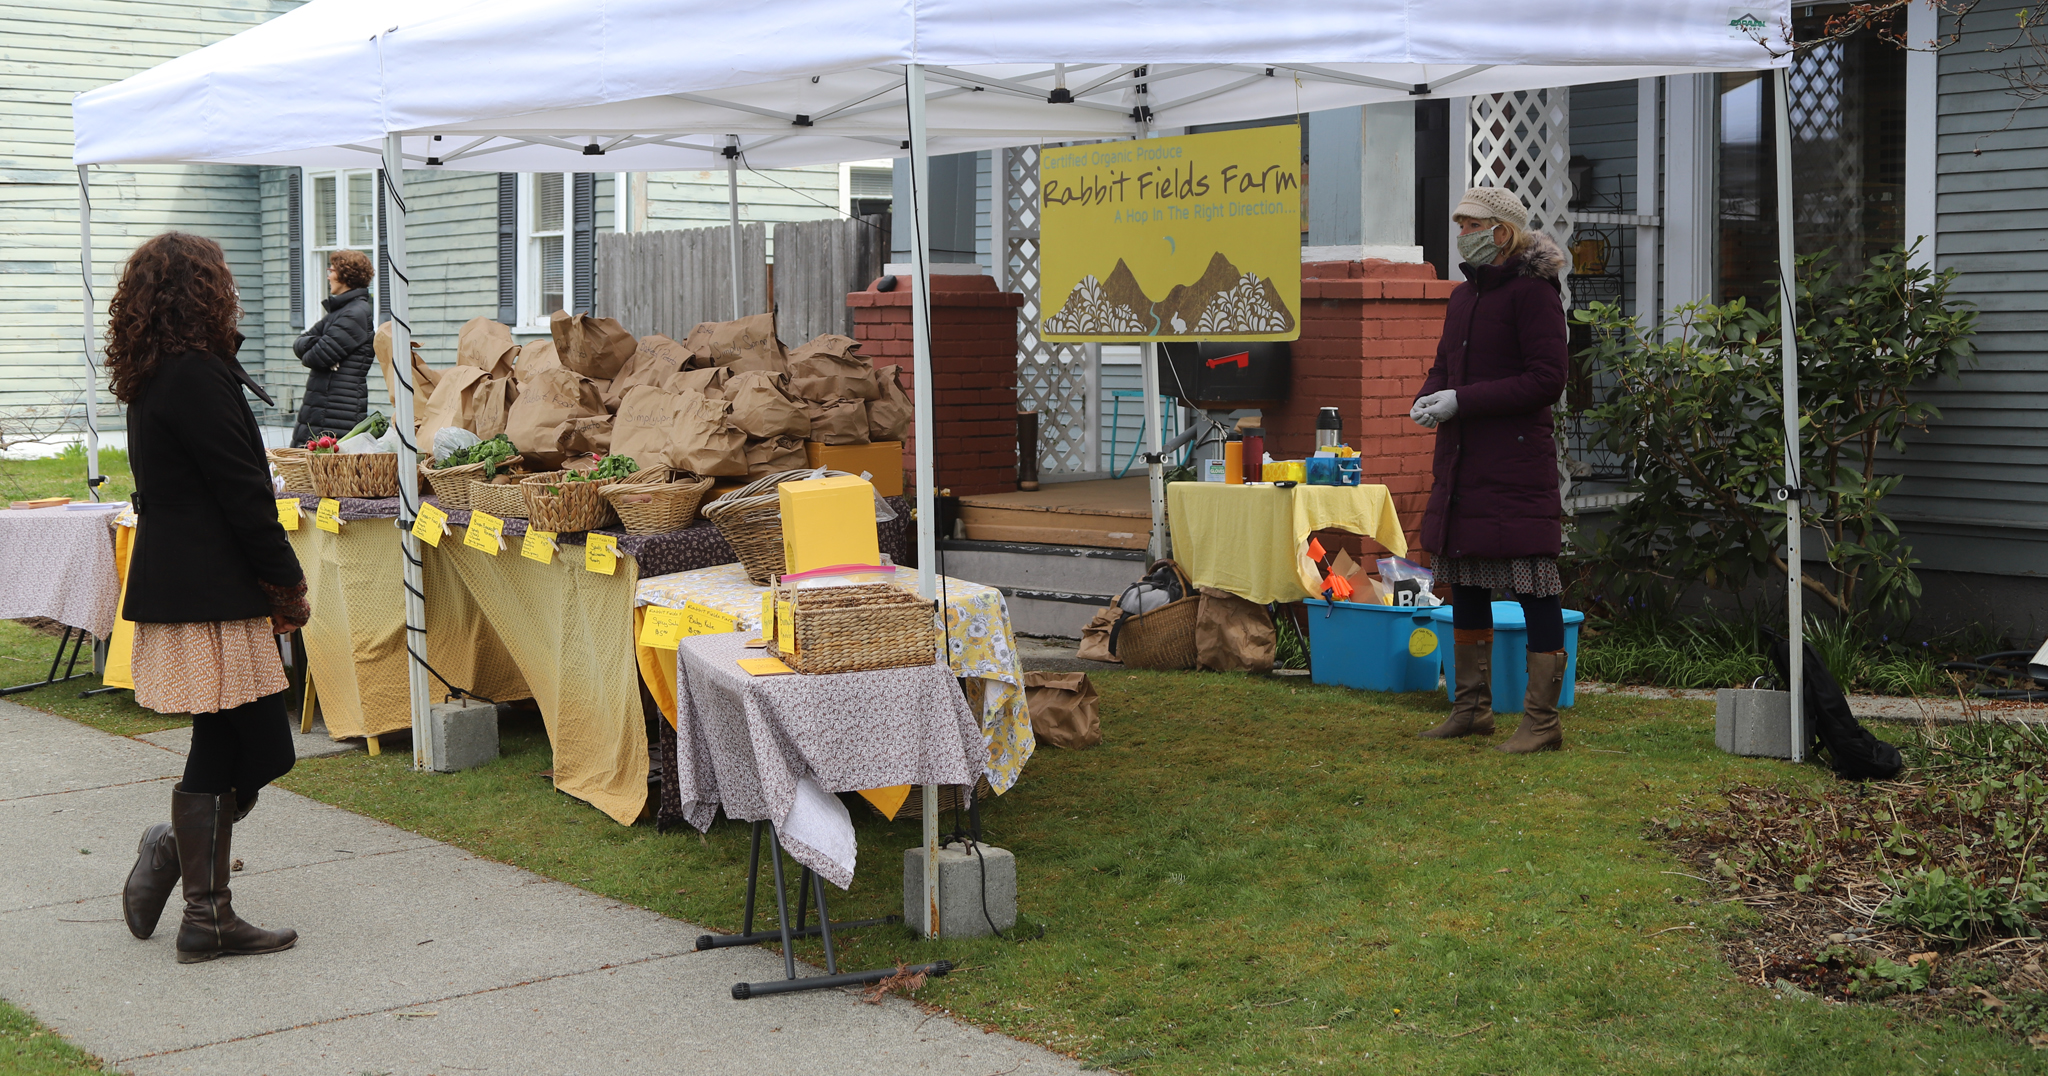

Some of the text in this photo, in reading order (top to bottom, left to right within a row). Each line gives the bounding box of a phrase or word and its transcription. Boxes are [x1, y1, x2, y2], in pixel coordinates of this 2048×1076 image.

[1043, 145, 1182, 170] Certified Organic Produce
[1043, 160, 1298, 208] Rabbit Fields Farm
[1114, 200, 1296, 225] A Hop In The Right Direction...
